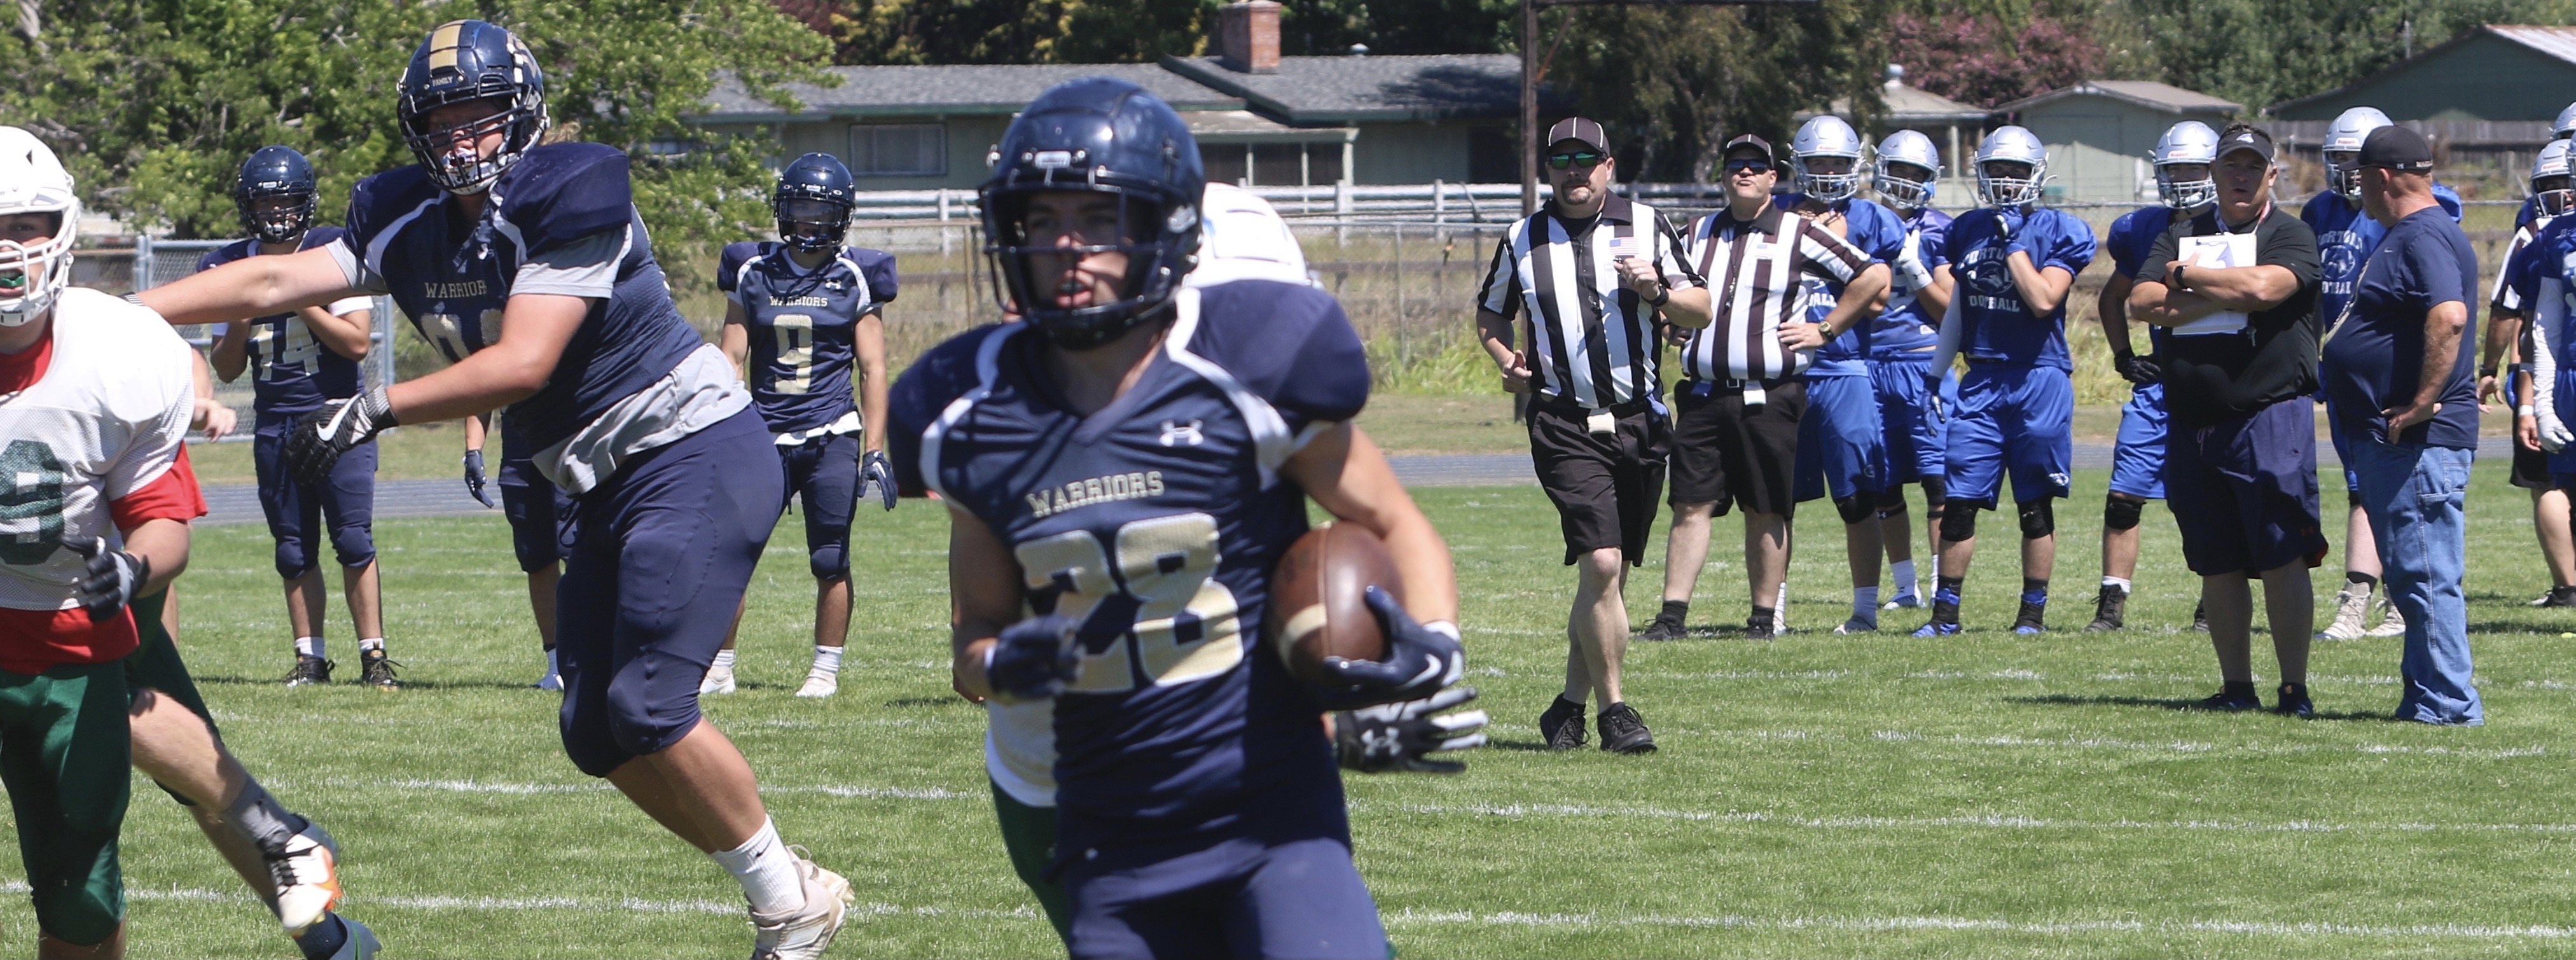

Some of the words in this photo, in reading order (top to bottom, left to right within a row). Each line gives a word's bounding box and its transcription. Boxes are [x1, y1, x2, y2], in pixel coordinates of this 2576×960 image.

[773, 314, 813, 394] 9
[1025, 471, 1165, 518] WARRIORS
[1014, 511, 1244, 693] 28
